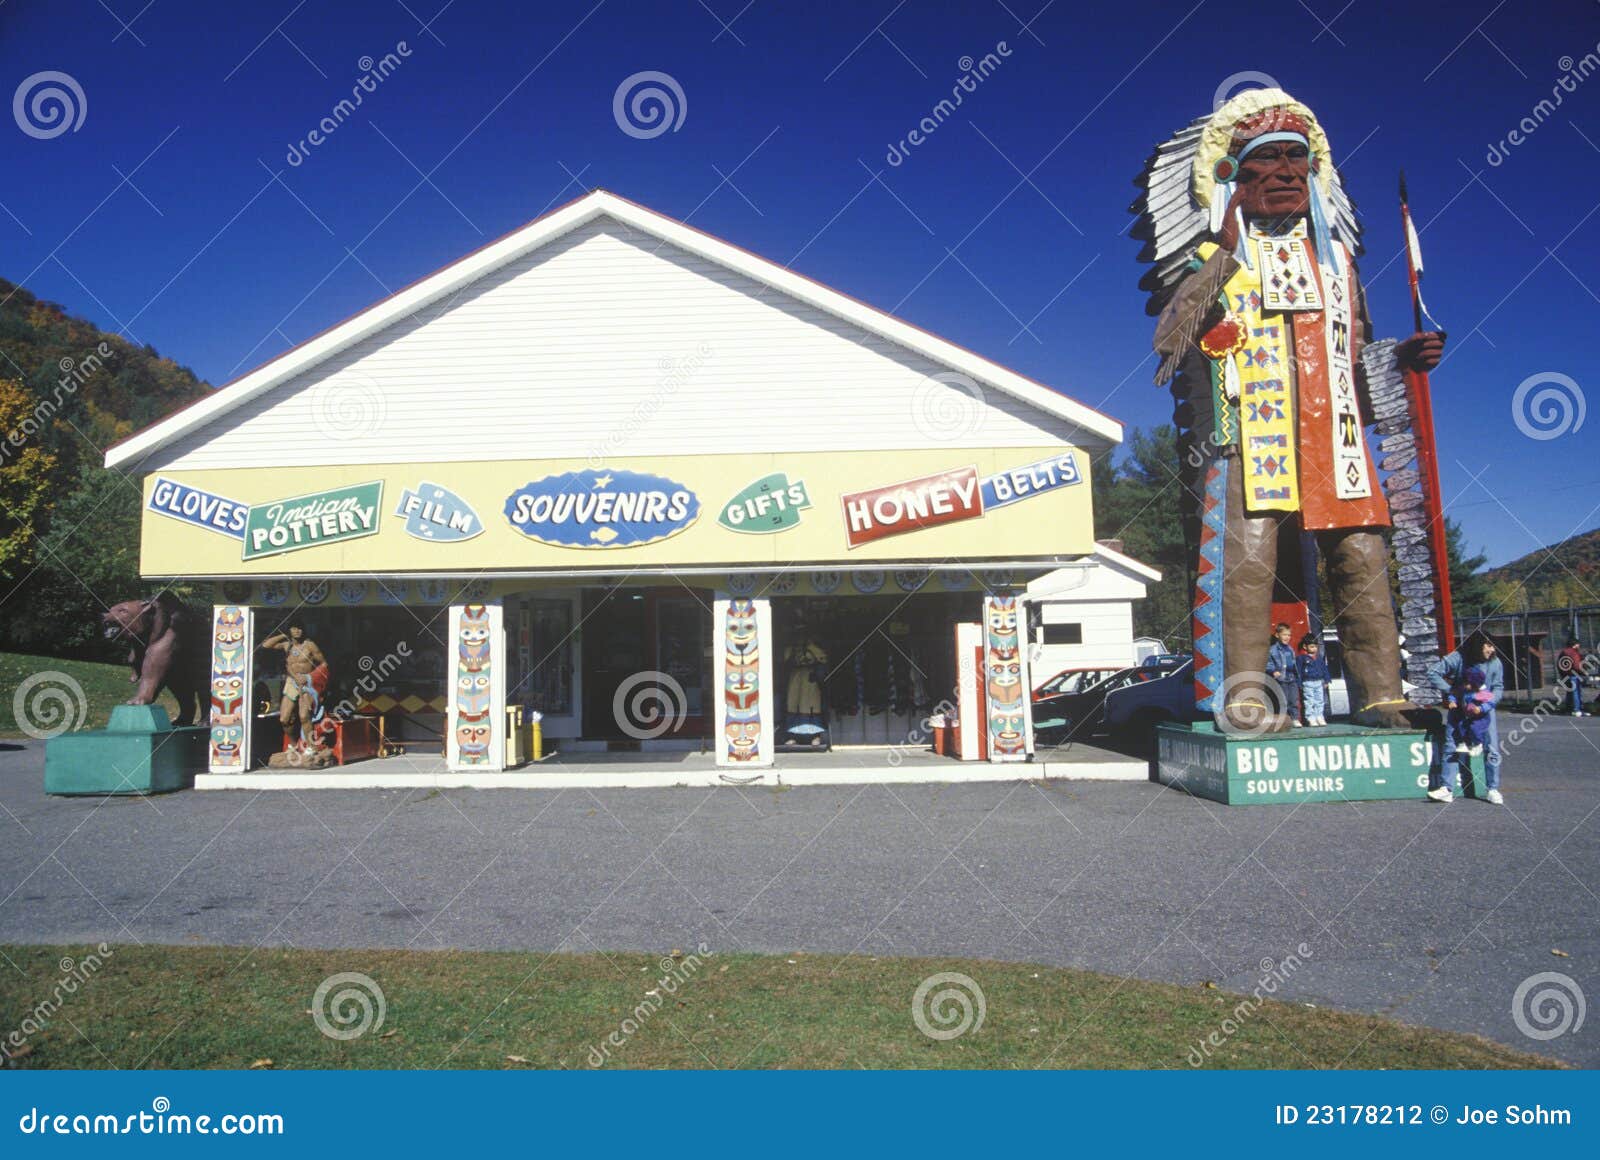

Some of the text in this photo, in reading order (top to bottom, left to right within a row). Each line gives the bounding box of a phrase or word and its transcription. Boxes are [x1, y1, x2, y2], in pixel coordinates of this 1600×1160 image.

[993, 456, 1076, 501] BELTS
[155, 482, 248, 531] GLOVES
[266, 497, 361, 527] Indian
[404, 495, 473, 533] FILM
[511, 491, 690, 524] SOUVENIRS
[727, 485, 804, 524] GIFTS
[848, 477, 977, 532] HONEY
[251, 506, 374, 550] POTTERY
[1237, 748, 1279, 774] BIG
[1299, 743, 1391, 771] INDIAN
[1247, 778, 1344, 794] SOUVENIRS
